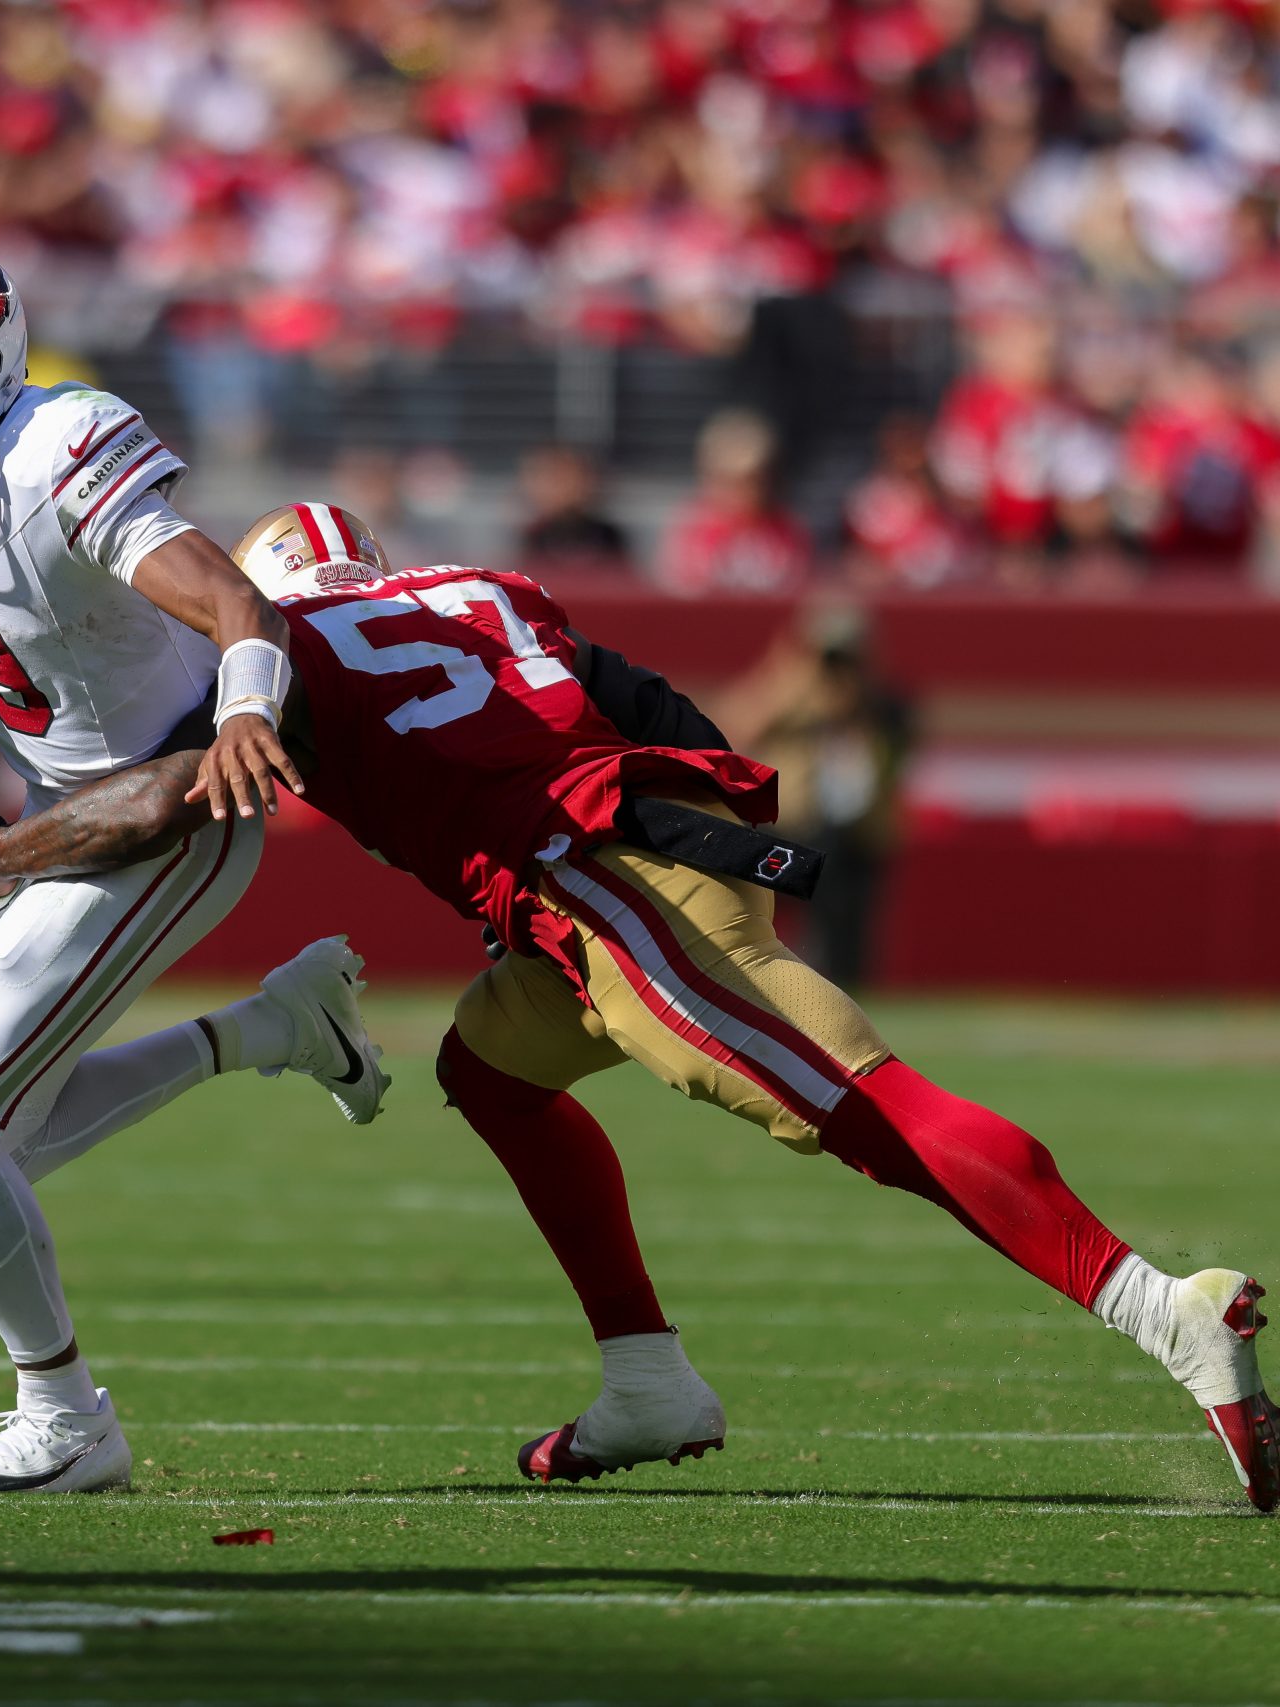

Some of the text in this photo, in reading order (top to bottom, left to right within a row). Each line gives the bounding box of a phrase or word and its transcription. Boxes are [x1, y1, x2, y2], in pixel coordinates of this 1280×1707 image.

[77, 432, 145, 499] CARDINALS
[286, 555, 302, 570] 64
[314, 563, 372, 586] 49ERS
[302, 579, 581, 735] 57
